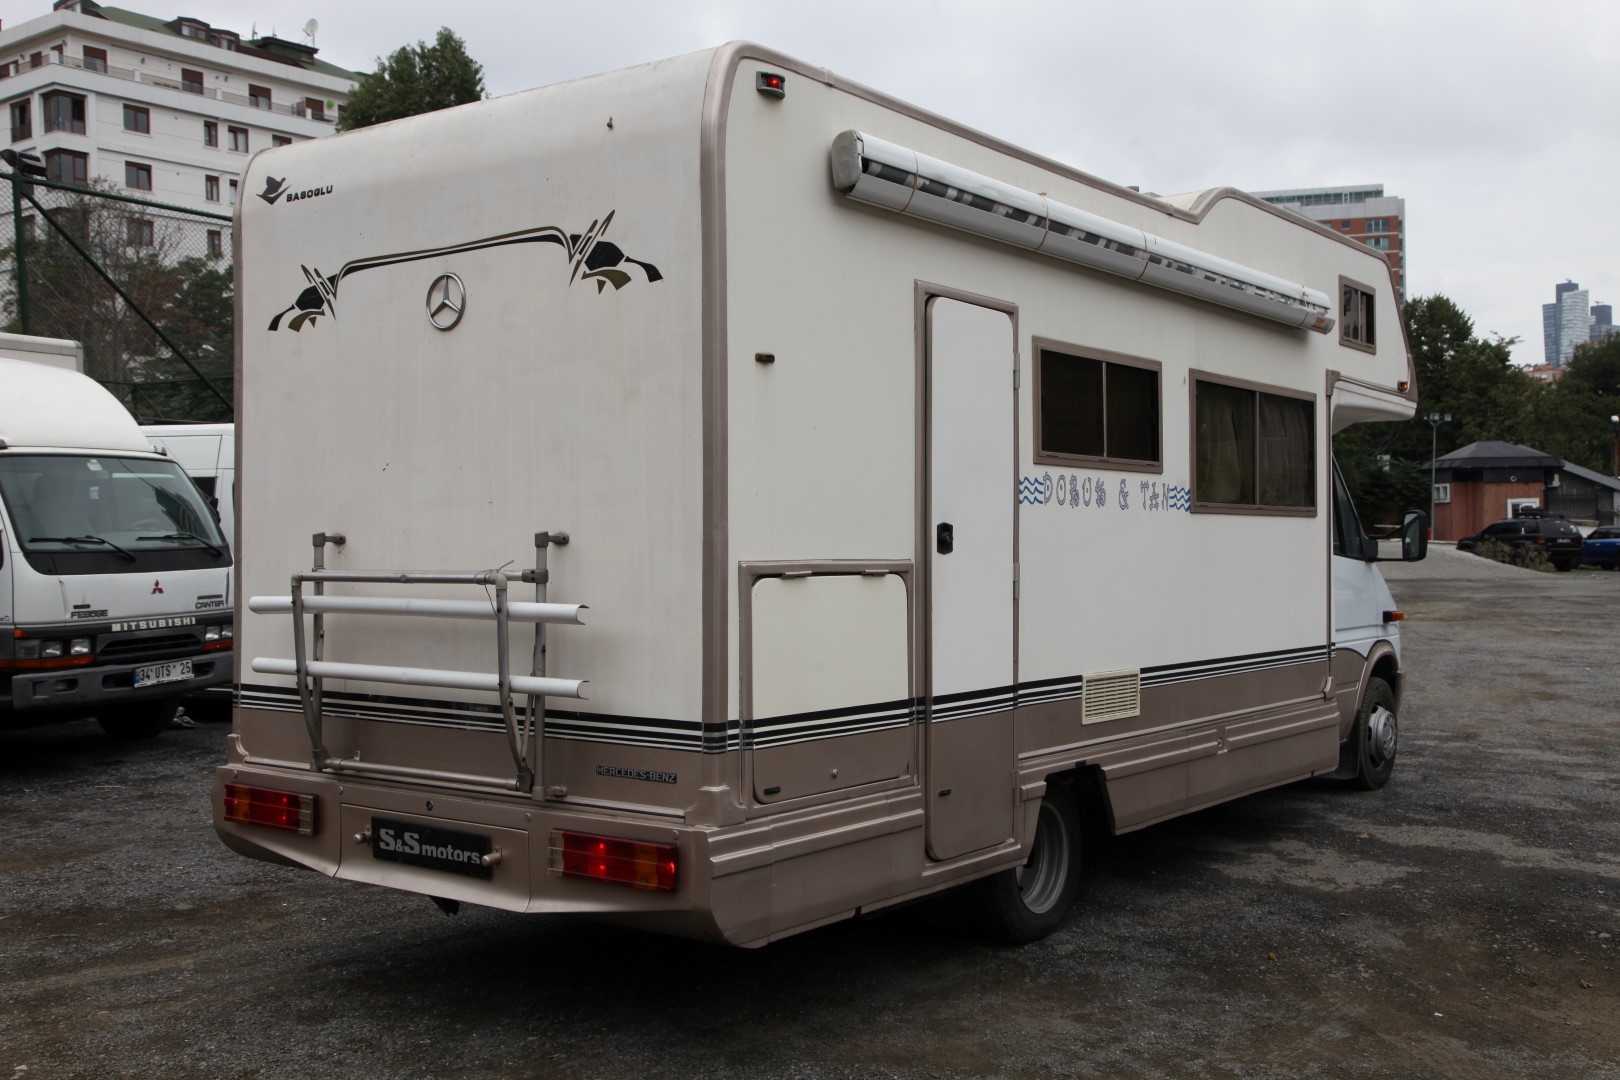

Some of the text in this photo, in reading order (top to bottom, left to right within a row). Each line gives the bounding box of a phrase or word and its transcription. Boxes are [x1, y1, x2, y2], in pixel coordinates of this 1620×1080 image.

[195, 600, 224, 609] CANTER
[111, 617, 196, 632] MITSUBISHI
[140, 668, 150, 681] 34
[155, 665, 171, 678] UTS
[180, 662, 191, 674] 25
